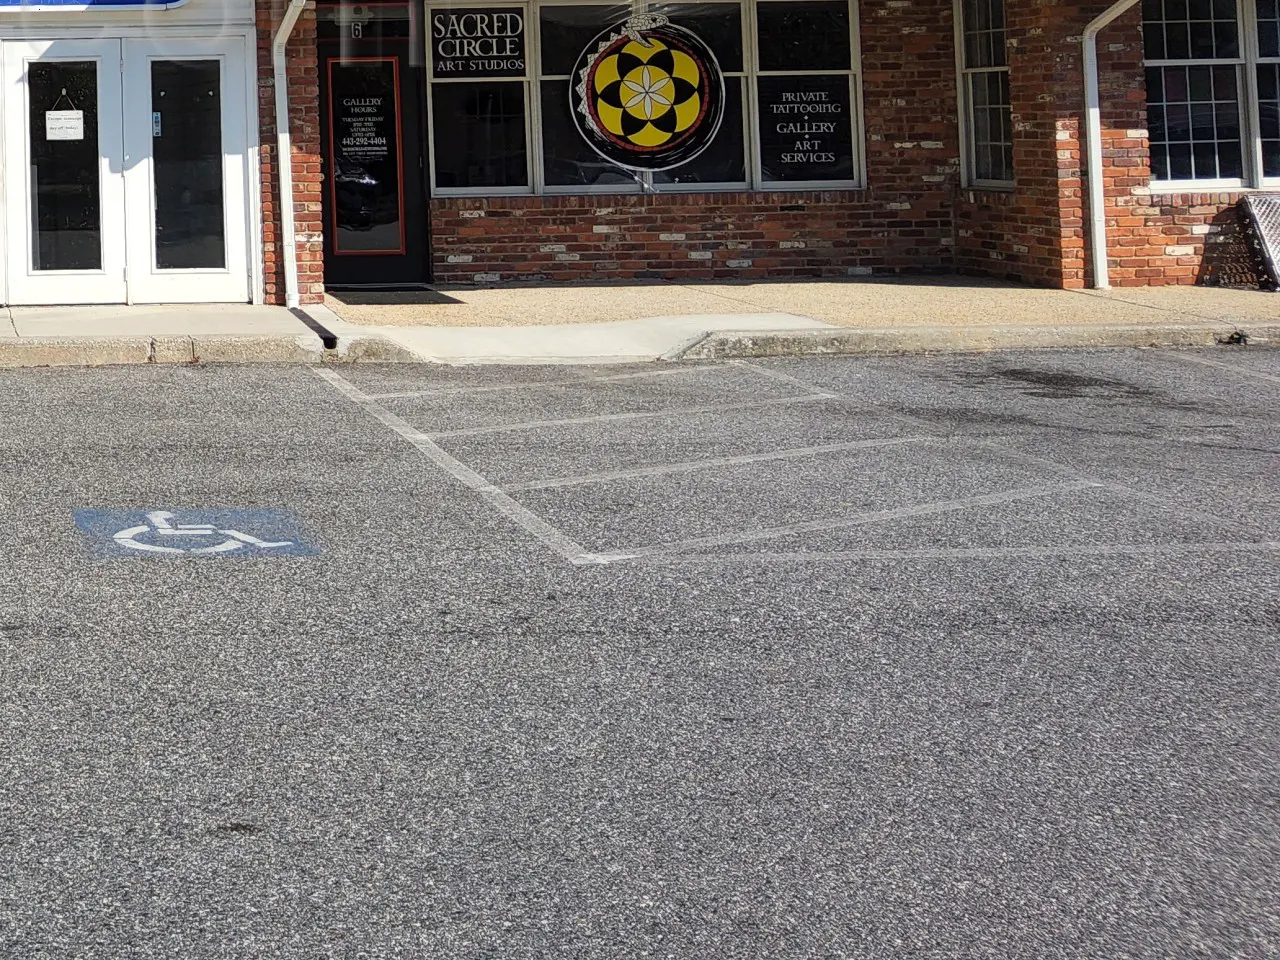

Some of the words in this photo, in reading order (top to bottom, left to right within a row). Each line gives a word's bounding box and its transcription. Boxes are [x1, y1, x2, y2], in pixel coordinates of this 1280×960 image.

[352, 22, 361, 38] 6
[433, 13, 523, 38] SACRED
[438, 38, 520, 57] CIRCLE
[437, 60, 466, 71] ART
[469, 59, 525, 70] STUDIOS
[343, 98, 382, 106] GALLERY
[782, 92, 829, 101] PRIVATE
[776, 122, 837, 133] GALLERY
[794, 141, 821, 150] ART
[781, 152, 836, 163] SERVICES
